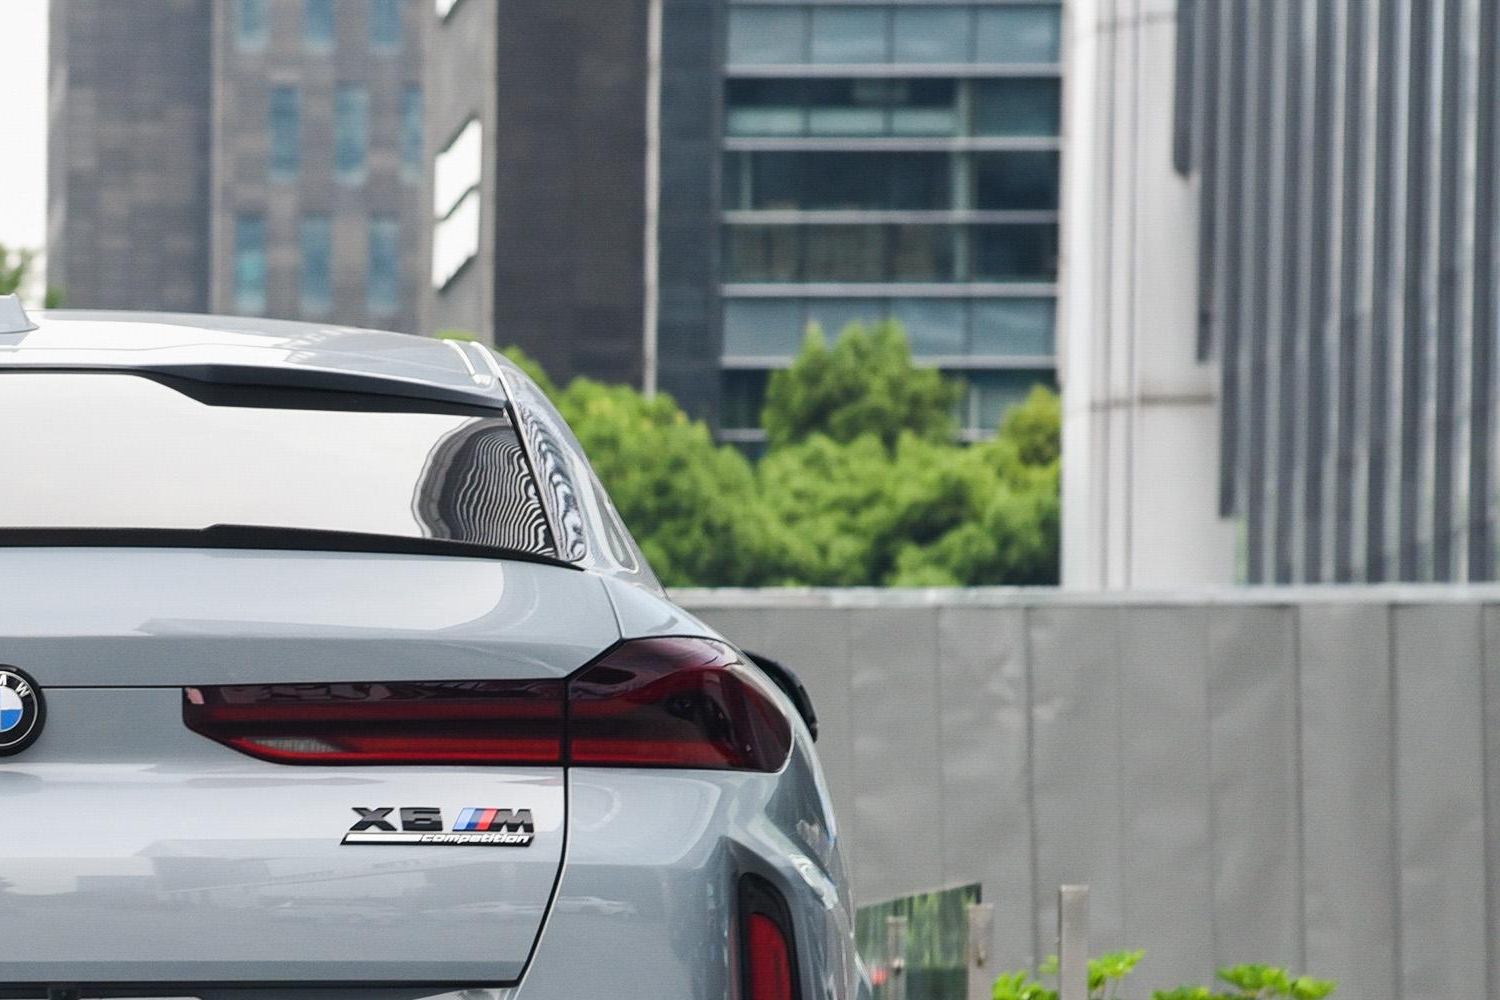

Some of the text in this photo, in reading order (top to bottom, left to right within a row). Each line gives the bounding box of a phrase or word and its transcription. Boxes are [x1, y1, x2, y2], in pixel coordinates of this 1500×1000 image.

[350, 807, 534, 833] X6 M
[421, 833, 530, 844] competition
